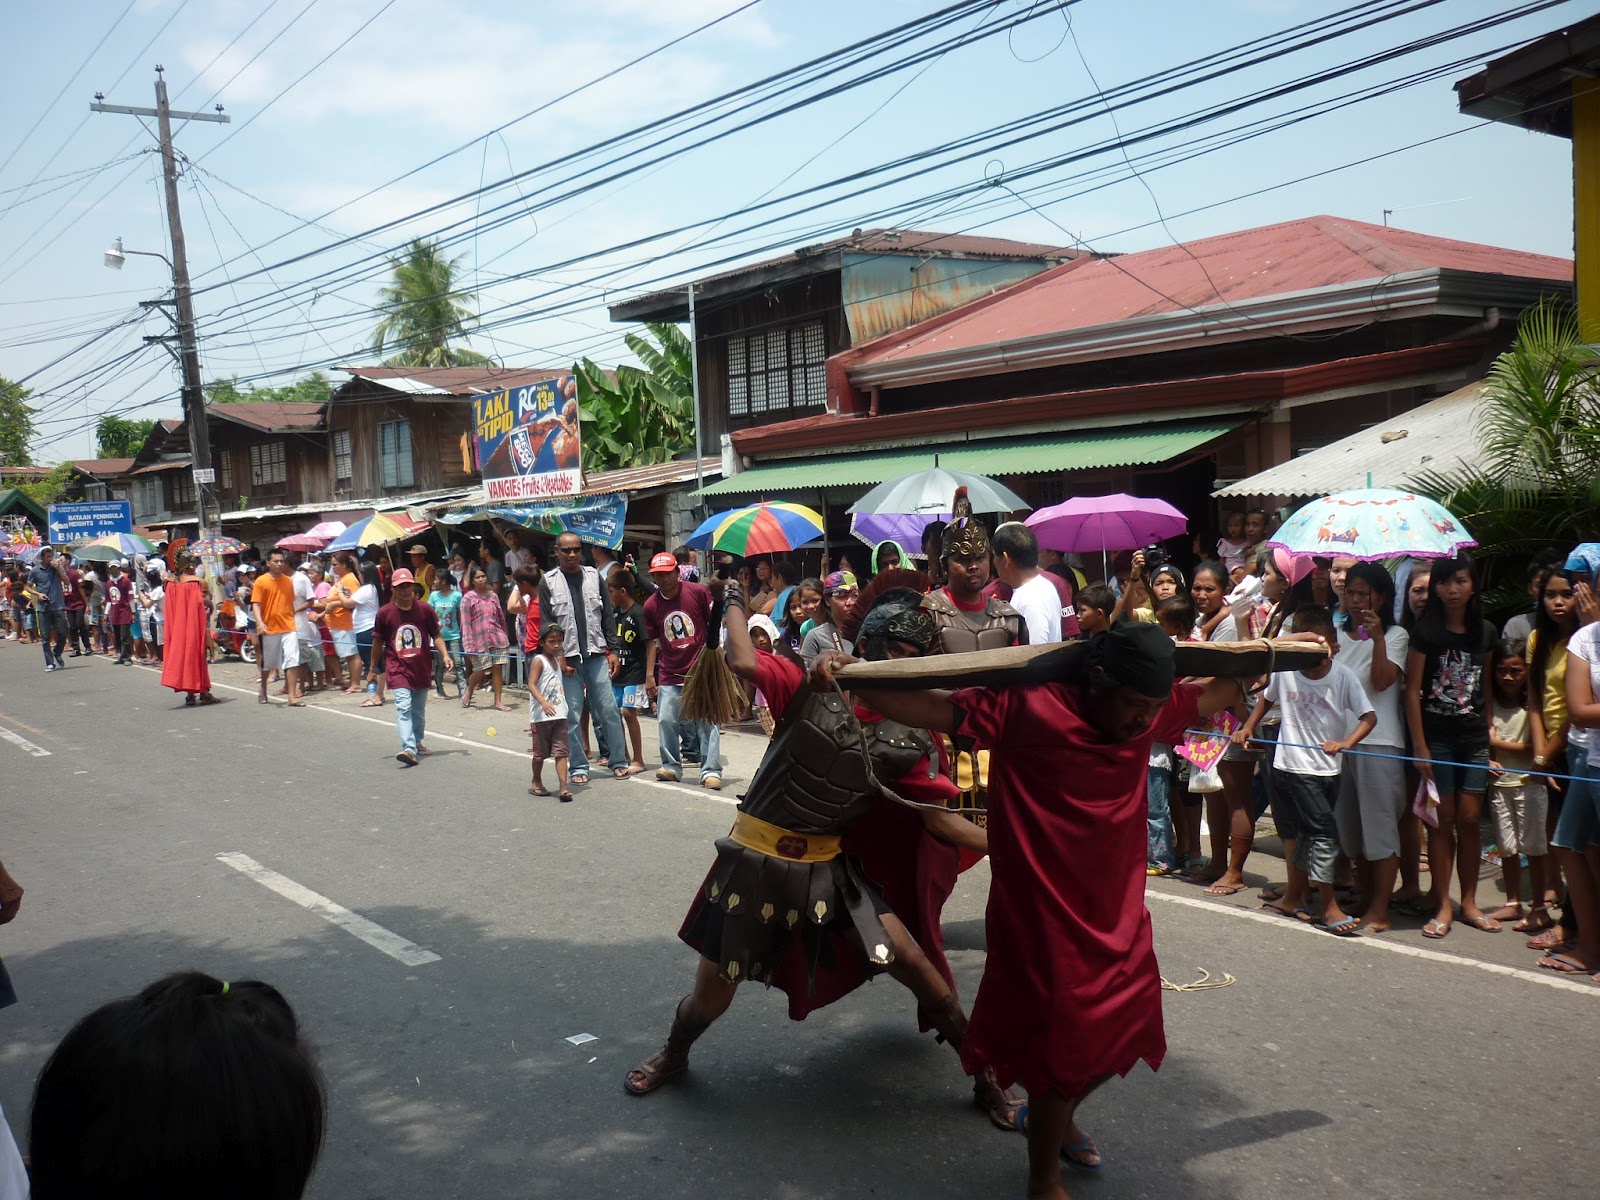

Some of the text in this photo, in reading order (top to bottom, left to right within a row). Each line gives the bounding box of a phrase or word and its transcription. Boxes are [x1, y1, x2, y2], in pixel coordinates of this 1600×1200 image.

[477, 389, 510, 427] LAKI
[518, 385, 537, 420] RC
[483, 410, 514, 442] TIPID
[517, 432, 533, 465] MEGA
[522, 476, 540, 496] Fruits
[58, 531, 89, 541] BNAS
